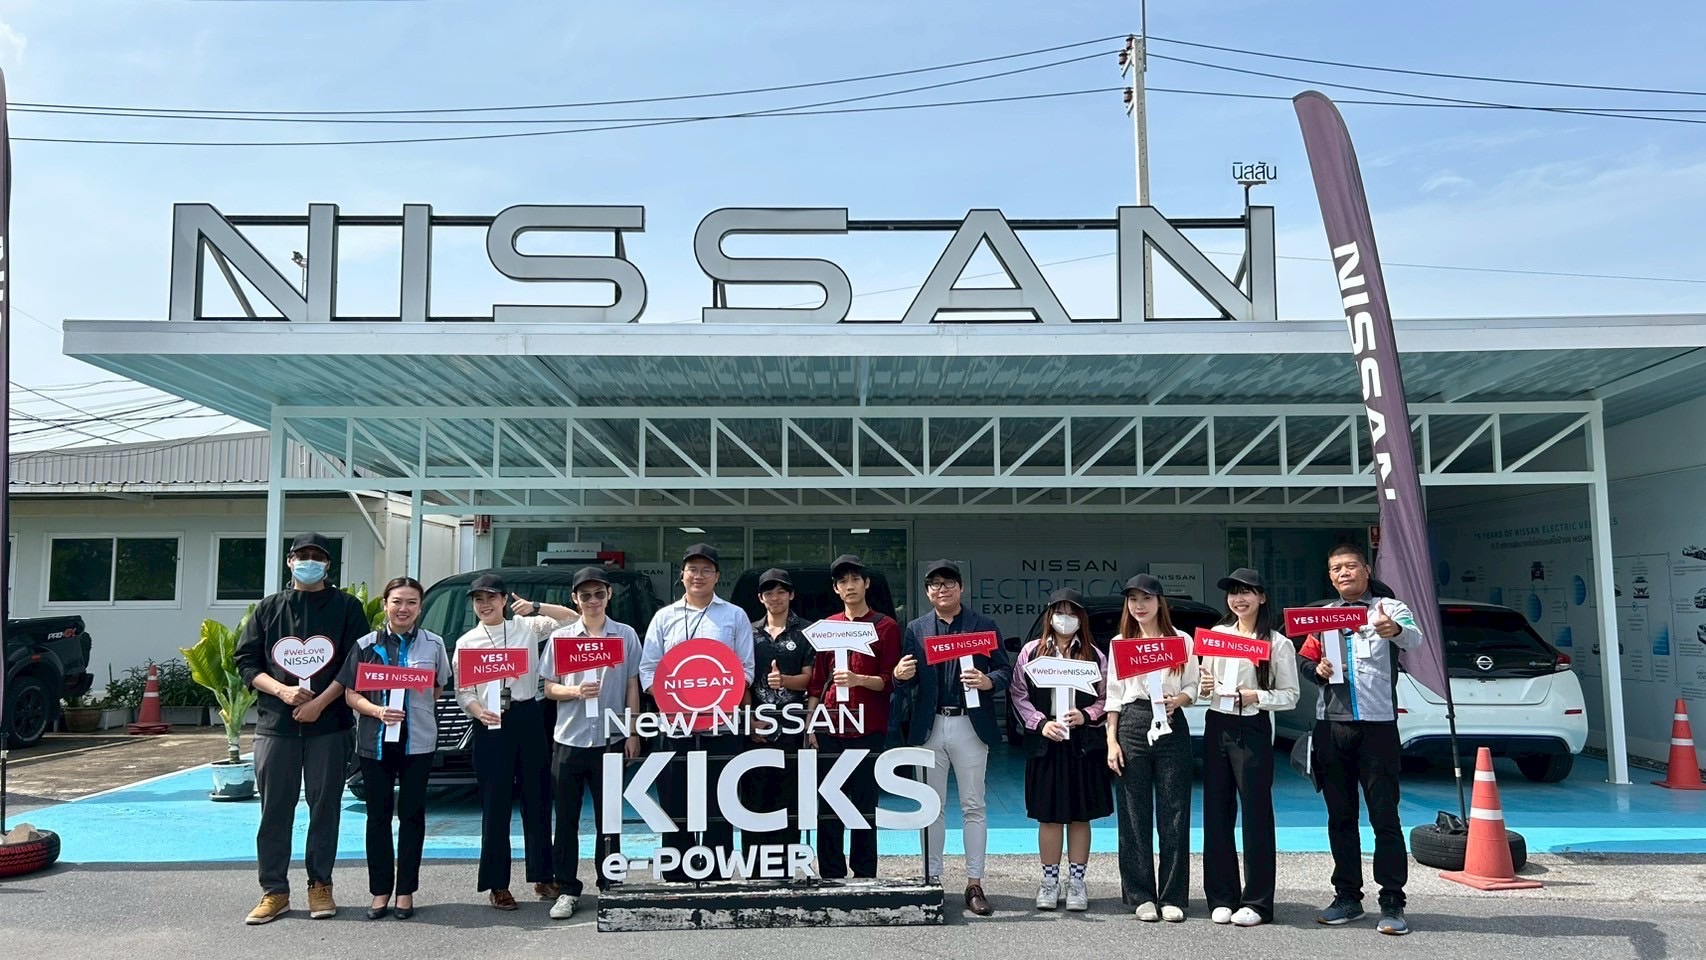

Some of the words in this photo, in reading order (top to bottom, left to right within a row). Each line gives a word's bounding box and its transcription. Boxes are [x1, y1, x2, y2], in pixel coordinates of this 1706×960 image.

[1232, 161, 1277, 180] นิสสัน
[169, 203, 1277, 323] NISSAN
[1514, 527, 1540, 537] NISSAN
[1541, 522, 1577, 534] ELECTRIC
[1021, 559, 1118, 572] NISSAN
[1293, 616, 1319, 625] YES!
[1321, 613, 1361, 623] NISSAN
[811, 630, 874, 639] #WeDriveNISSAN
[283, 647, 325, 656] #WeLove
[576, 642, 604, 651] YES!
[931, 642, 955, 653] YES!
[956, 638, 991, 649] NISSAN
[1135, 642, 1165, 653] YES!
[1201, 637, 1225, 648] YES!
[1227, 641, 1264, 654] NISSAN
[283, 655, 325, 666] NISSAN
[480, 653, 508, 662] YES!
[569, 652, 611, 663] NISSAN
[1129, 653, 1174, 666] NISSAN
[473, 663, 515, 674] NISSAN
[1032, 667, 1097, 676] #WeDriveNISSAN
[364, 672, 389, 681] YES!
[391, 673, 429, 683] NISSAN
[664, 676, 734, 690] NISSAN
[604, 707, 699, 738] New
[711, 703, 865, 736] NISSAN
[602, 747, 942, 834] KICKS
[602, 843, 816, 881] e-POWER
